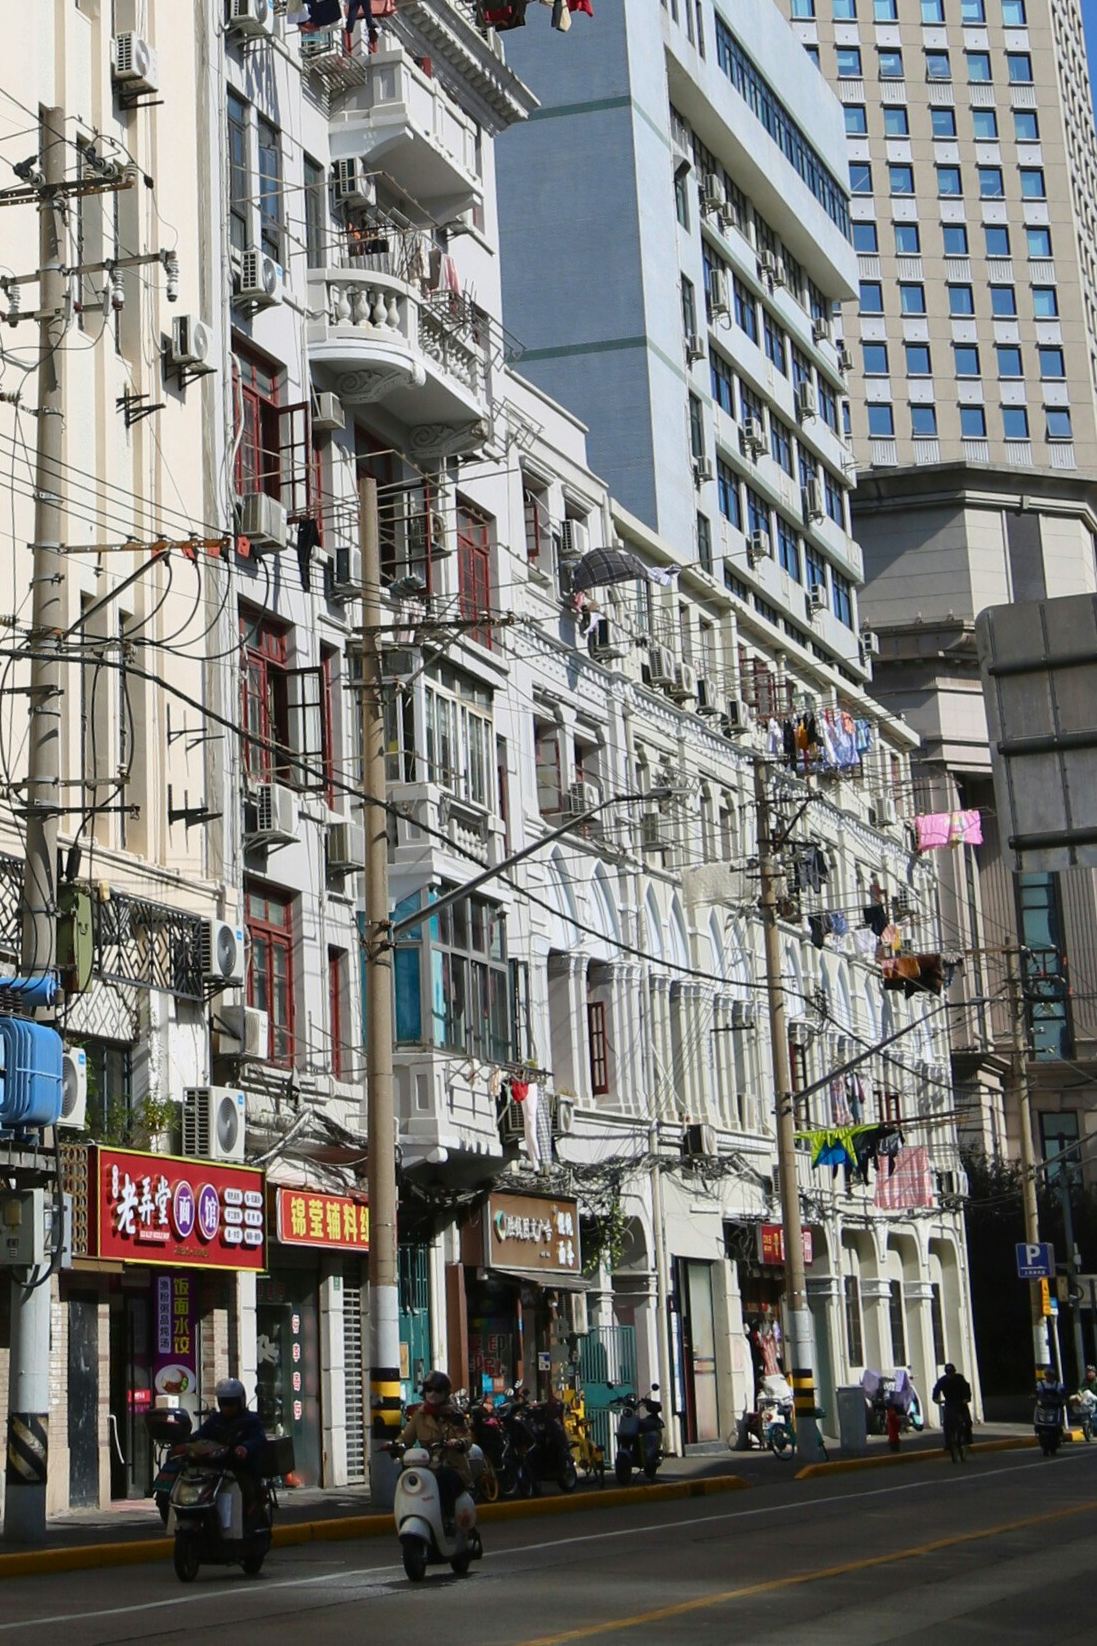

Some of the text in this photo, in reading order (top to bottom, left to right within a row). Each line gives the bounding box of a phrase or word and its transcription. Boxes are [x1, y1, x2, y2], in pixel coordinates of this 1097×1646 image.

[117, 1173, 217, 1234] 老弄堂面馆
[1026, 1244, 1041, 1266] P
[174, 1278, 190, 1354] 饭面水饺
